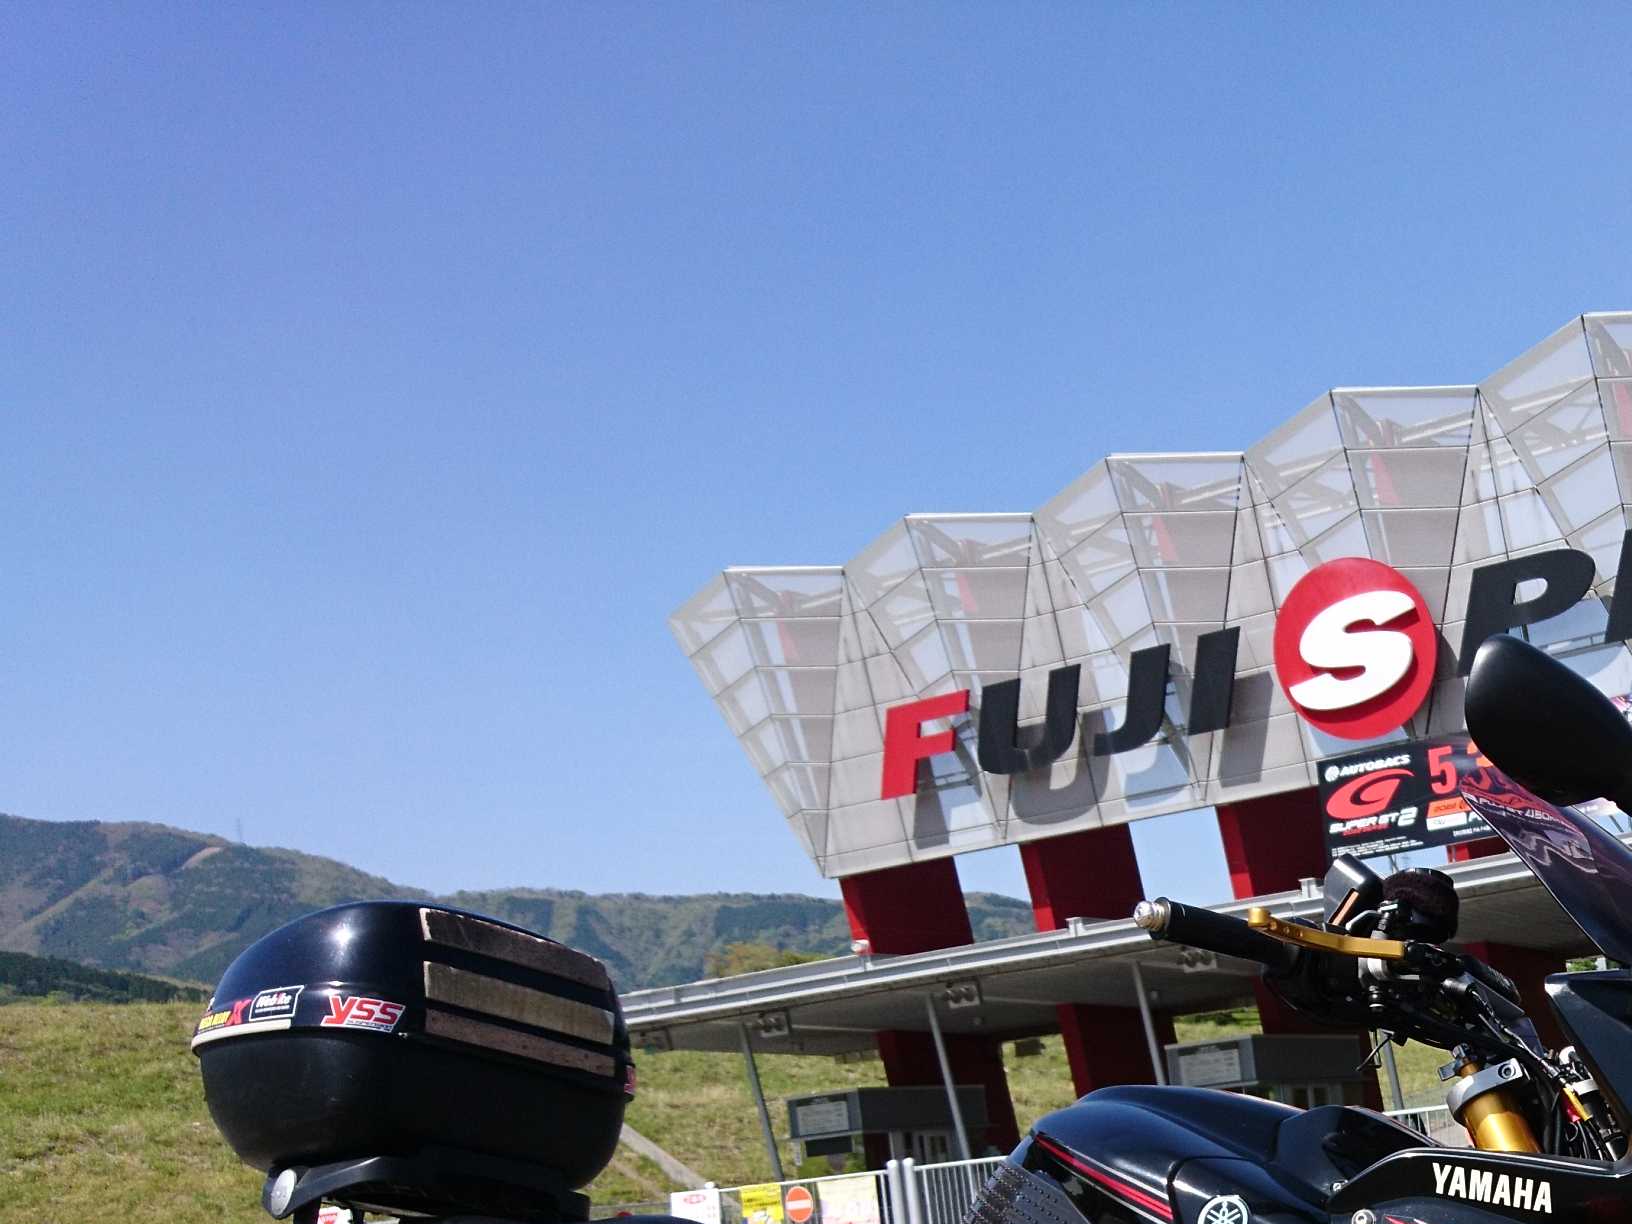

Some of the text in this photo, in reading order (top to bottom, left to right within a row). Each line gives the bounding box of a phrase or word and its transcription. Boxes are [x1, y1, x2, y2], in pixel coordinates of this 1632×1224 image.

[880, 626, 1241, 800] FUJI
[1339, 754, 1411, 777] AUTOBACS
[1432, 1162, 1552, 1214] YAMAHA
